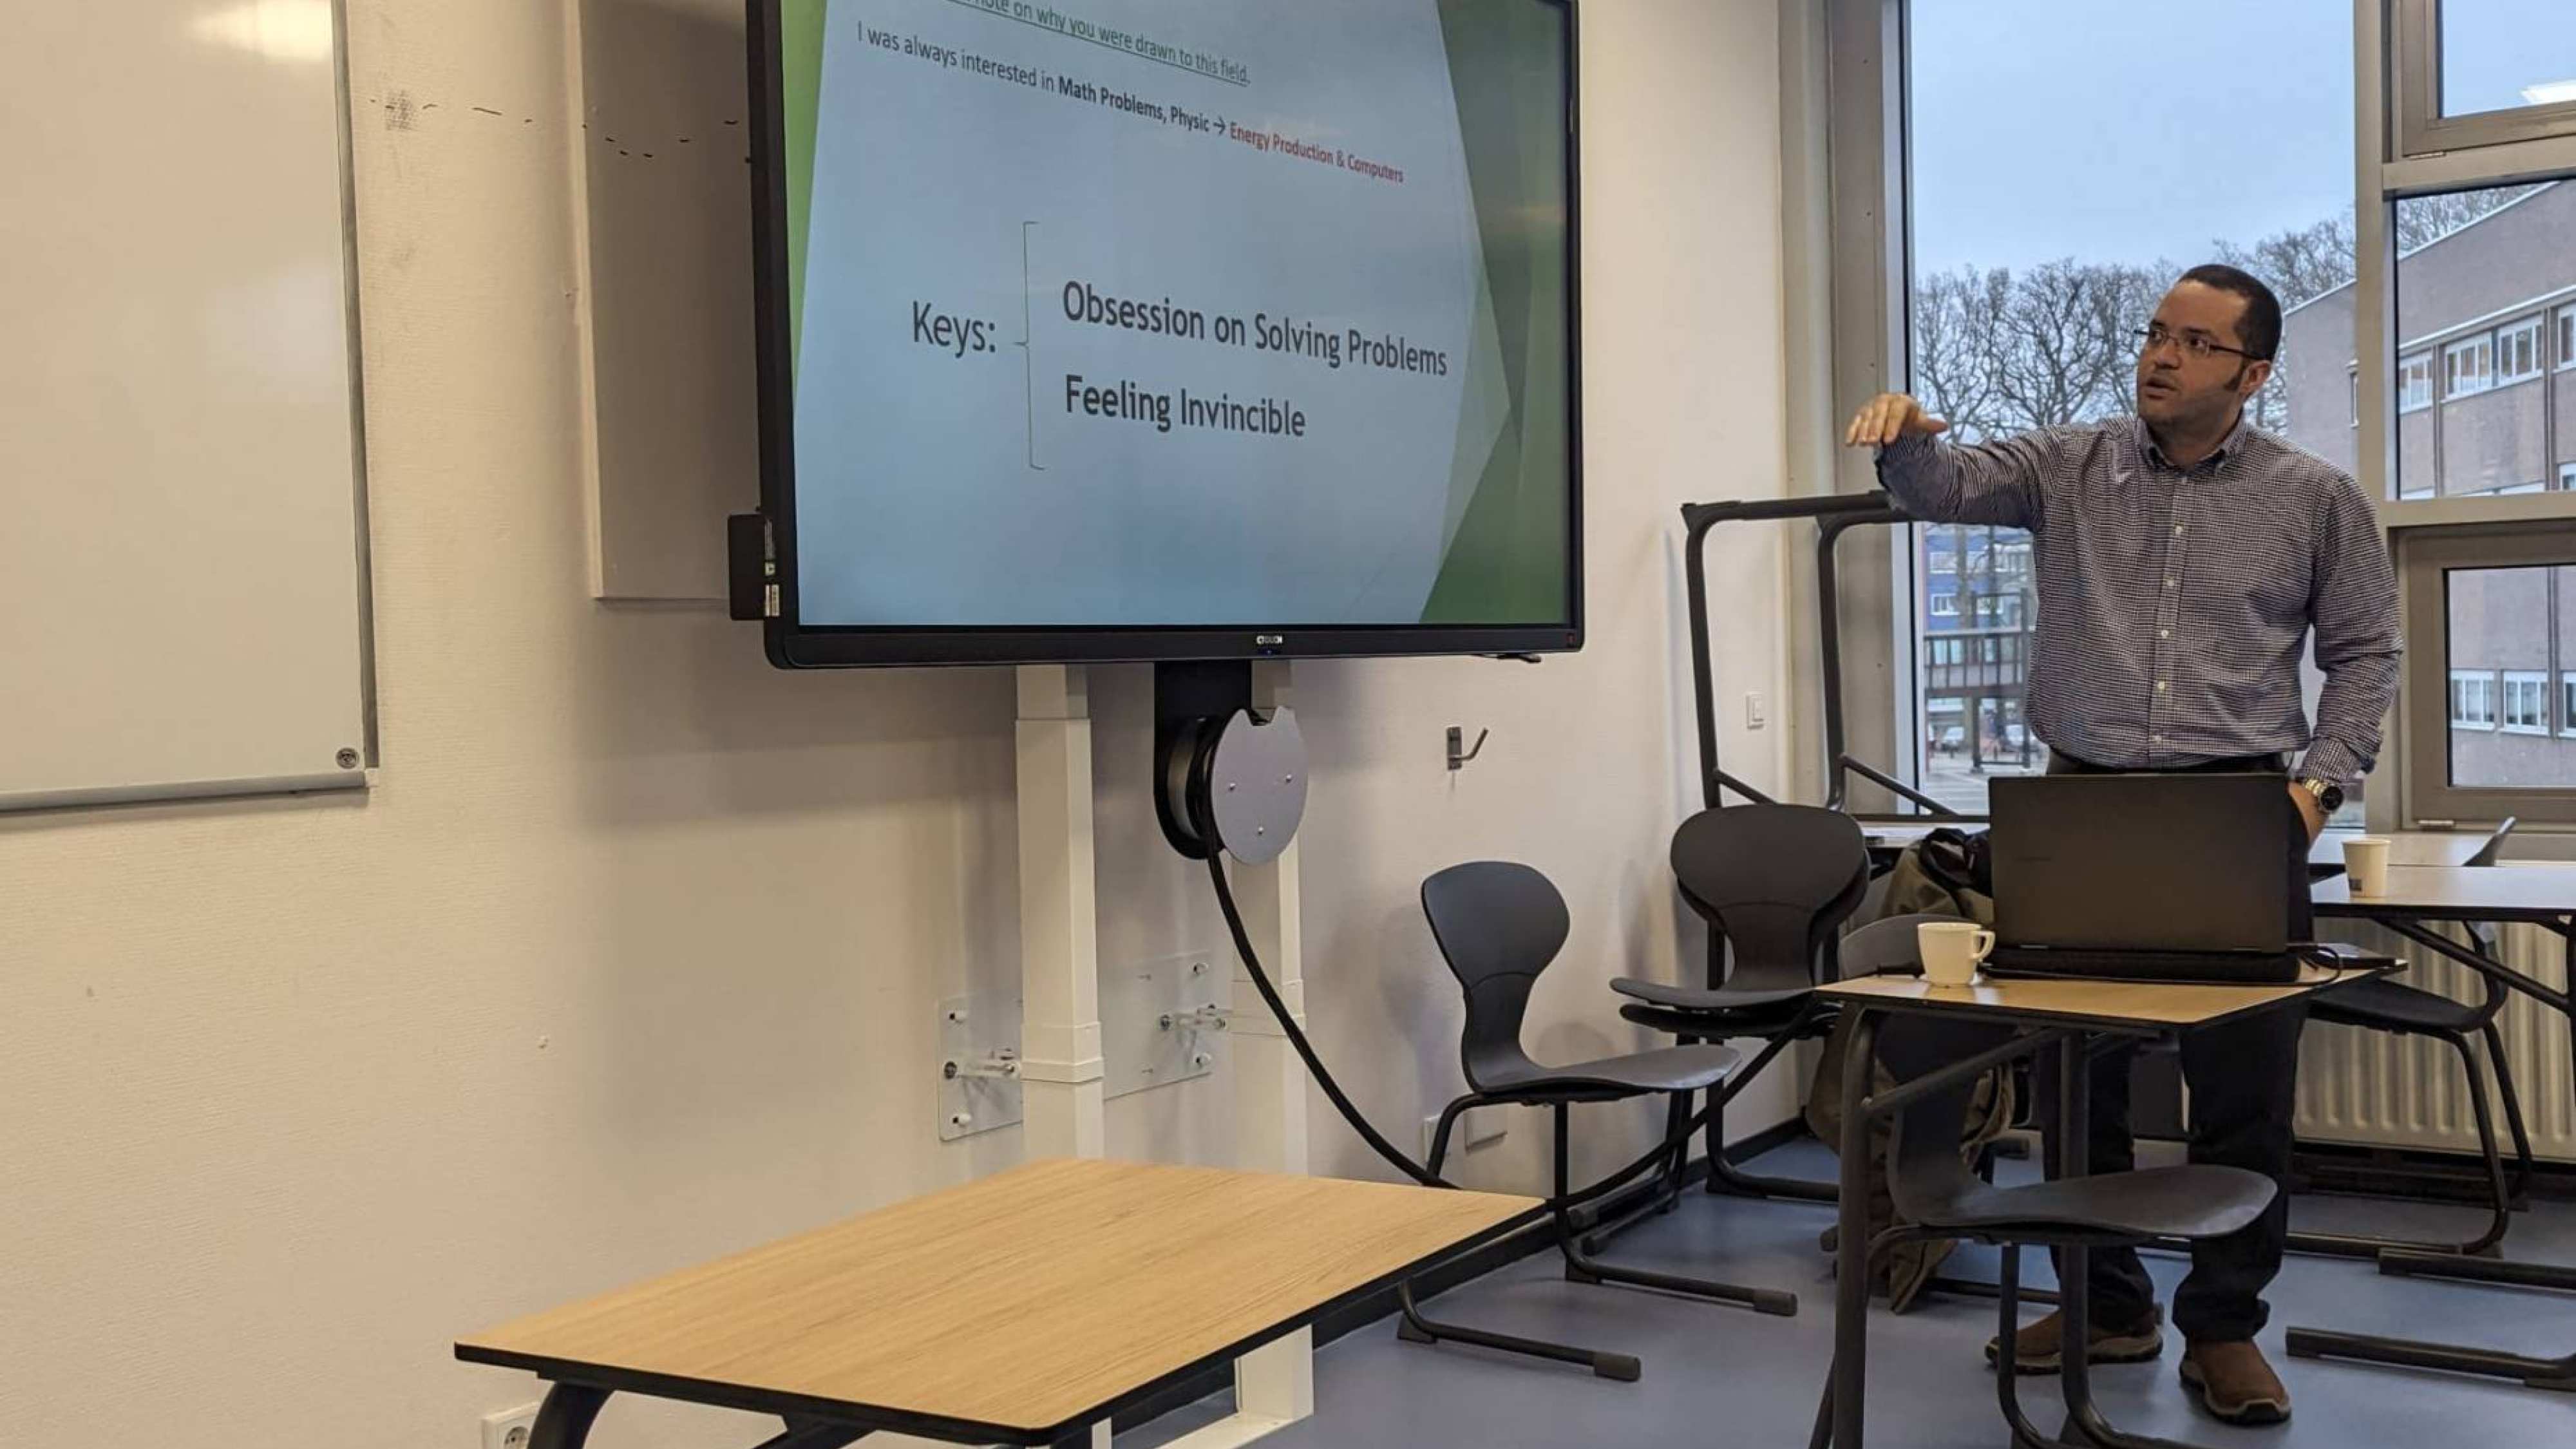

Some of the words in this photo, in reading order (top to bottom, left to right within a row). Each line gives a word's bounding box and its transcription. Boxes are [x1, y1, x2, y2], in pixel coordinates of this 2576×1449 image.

[1014, 2, 1032, 19] on
[1036, 6, 1066, 31] why
[1070, 15, 1095, 37] you
[1099, 26, 1132, 49] were
[1135, 34, 1176, 62] drawn
[1179, 48, 1191, 66] to
[1196, 53, 1218, 74] this
[857, 21, 862, 41] I
[867, 28, 900, 52] was
[904, 35, 958, 68] always
[961, 48, 1037, 87] interested
[1041, 70, 1054, 91] in
[1059, 75, 1097, 103] Math
[1100, 87, 1168, 124] Problems,
[1170, 106, 1209, 133] Physic
[1229, 121, 1271, 152] Energy
[1273, 133, 1334, 166] Production
[1336, 149, 1345, 168] &
[1347, 154, 1405, 183] Computers
[913, 300, 996, 358] Keys:
[1063, 280, 1205, 340] Obsession
[1215, 315, 1246, 346] on
[1255, 312, 1341, 369] Solving
[1349, 328, 1448, 376] Problems
[1066, 374, 1172, 433] Feeling
[1180, 388, 1307, 437] Invincible
